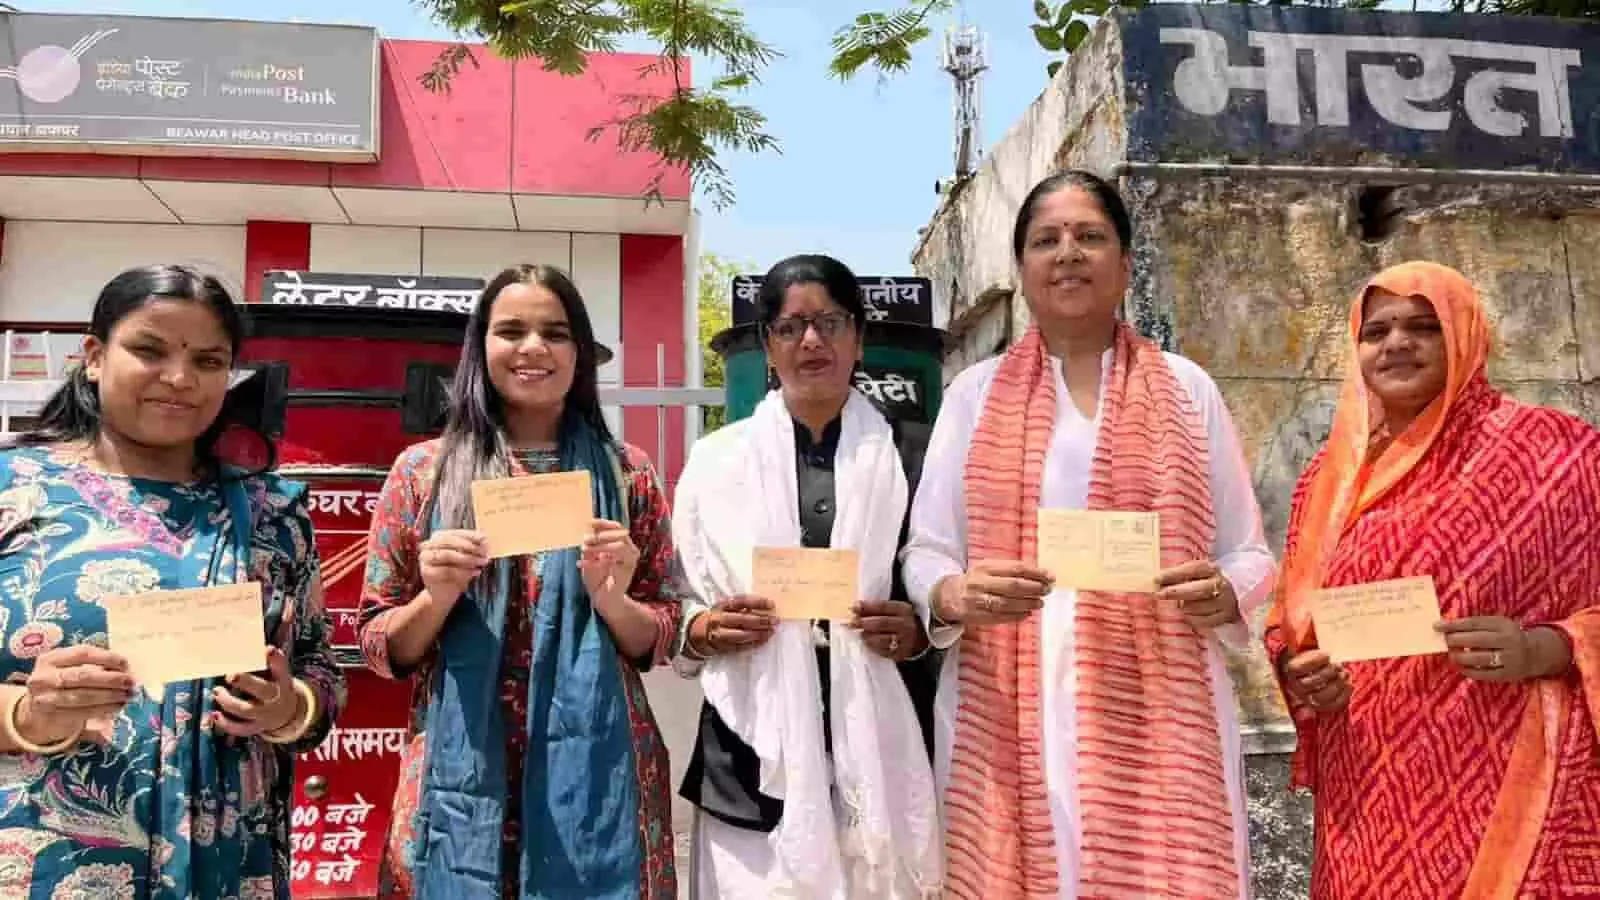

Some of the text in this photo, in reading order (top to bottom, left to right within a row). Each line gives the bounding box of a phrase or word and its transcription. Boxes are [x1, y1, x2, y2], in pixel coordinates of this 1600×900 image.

[135, 56, 182, 77] पोस्ट
[263, 64, 304, 81] Post
[147, 75, 192, 98] बैंक
[1160, 27, 1582, 138] भारत
[284, 87, 336, 105] Bank
[167, 128, 360, 145] BEAWAR HEAD POST OFFICE
[342, 728, 407, 762] समय
[325, 792, 376, 825] बजे
[320, 825, 368, 854] बजे
[315, 853, 363, 885] बजे
